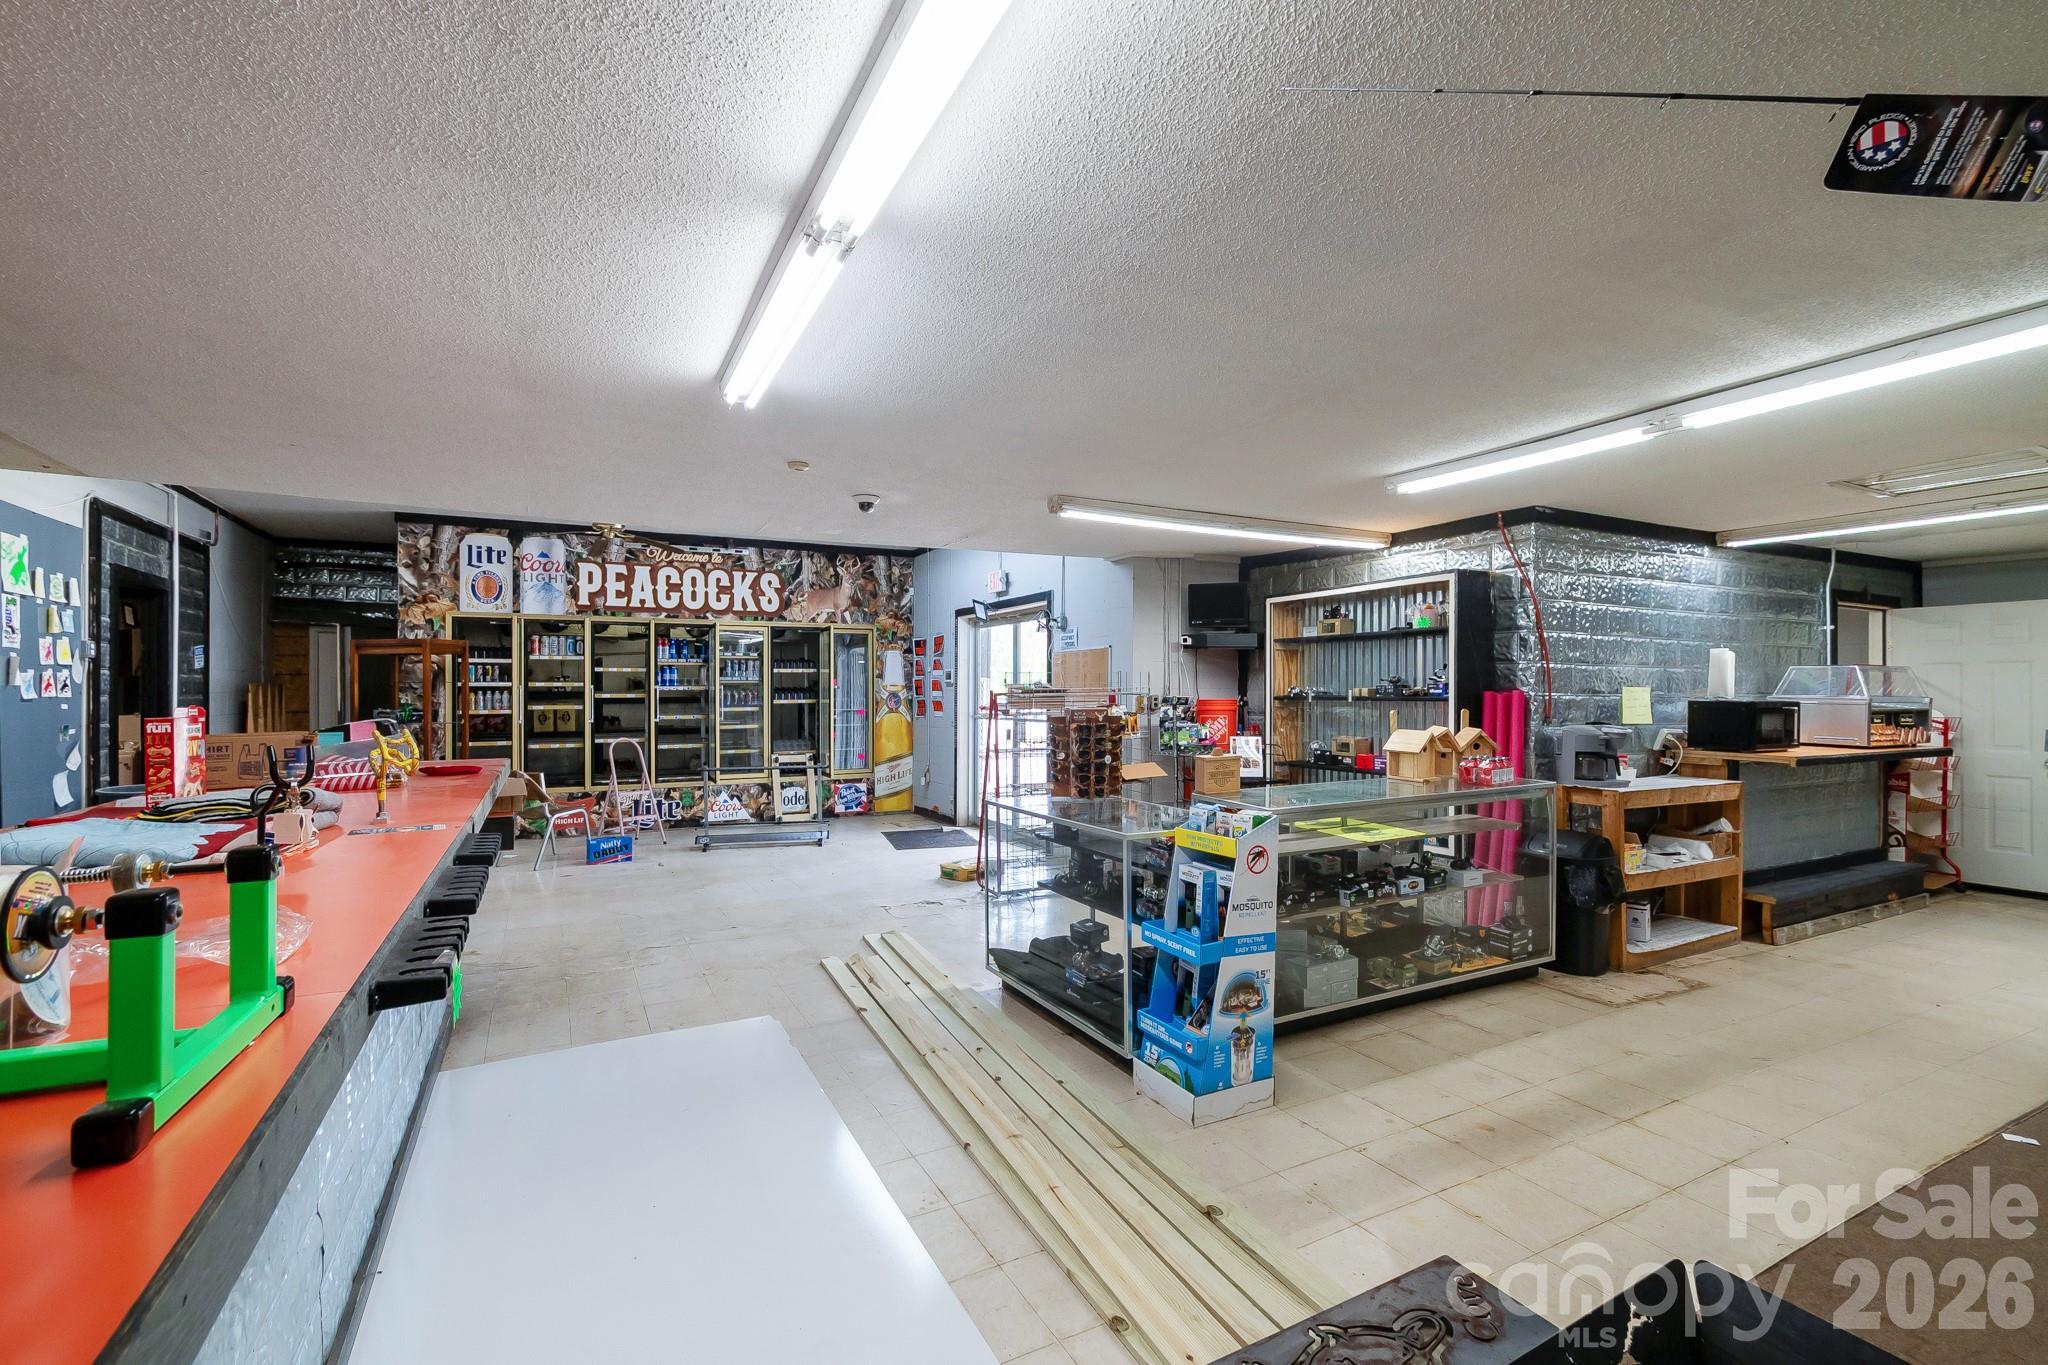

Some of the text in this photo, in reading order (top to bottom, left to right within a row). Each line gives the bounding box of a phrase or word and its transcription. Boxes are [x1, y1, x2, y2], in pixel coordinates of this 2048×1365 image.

[466, 545, 507, 568] Lite
[711, 552, 723, 563] to
[520, 552, 567, 574] Coors
[523, 574, 564, 583] LIGHT
[577, 562, 781, 613] PEACOCKS
[146, 723, 171, 733] fun
[1208, 715, 1227, 736] OME
[208, 745, 229, 753] HIRT
[876, 773, 896, 785] HIGH
[782, 791, 808, 806] odel
[710, 800, 742, 812] Coors
[631, 799, 682, 829] Lite
[600, 839, 622, 850] Natty
[593, 844, 629, 859] DADDY
[1232, 900, 1274, 911] MOSQUITO
[1235, 946, 1249, 954] EASY
[1258, 943, 1267, 951] USE
